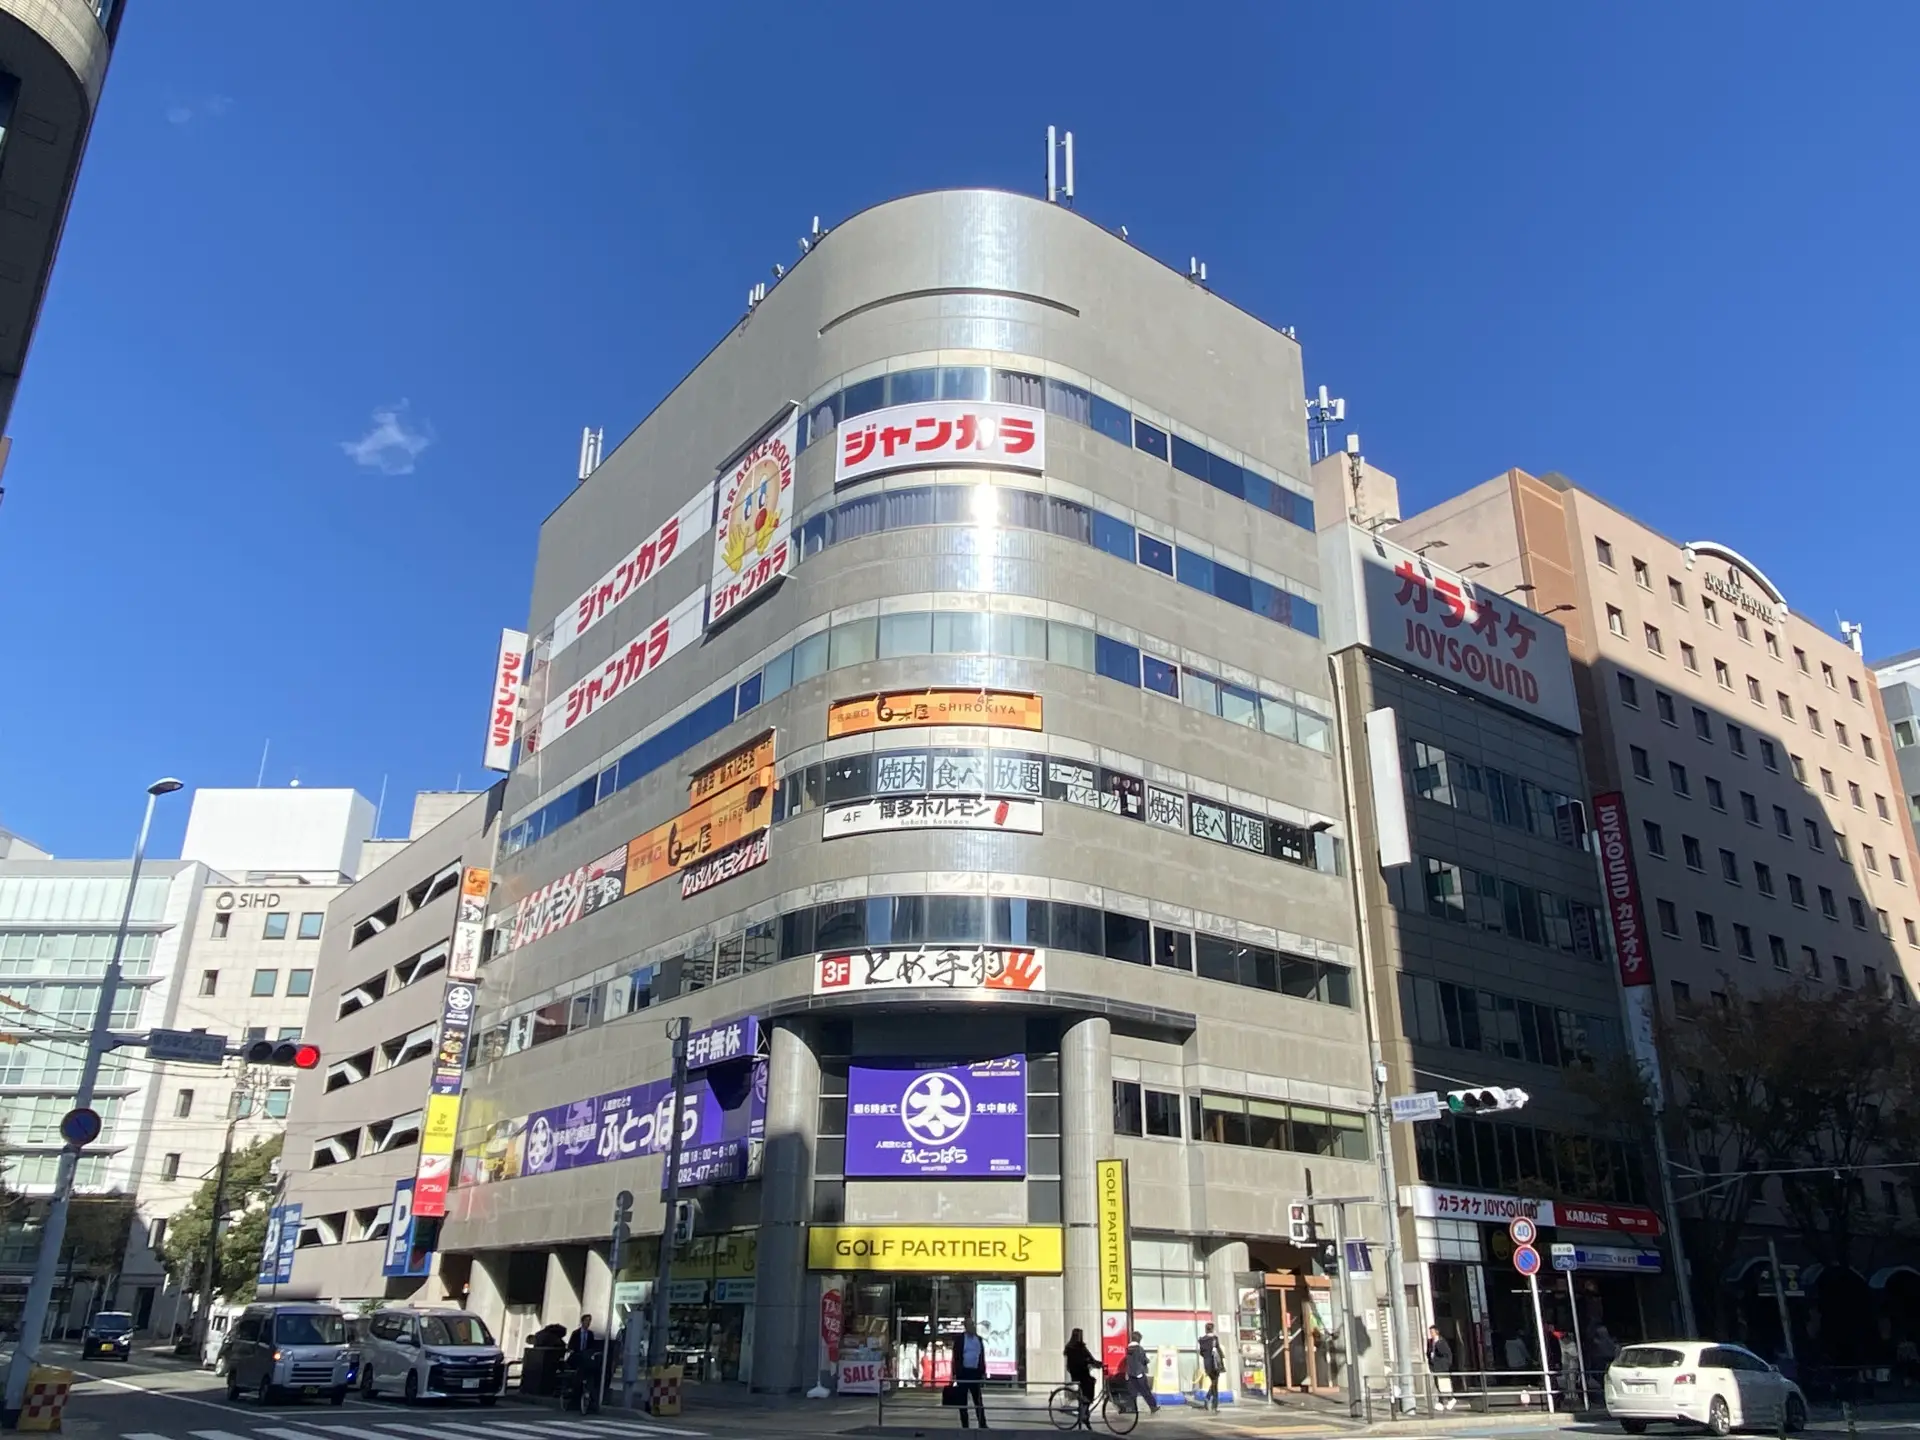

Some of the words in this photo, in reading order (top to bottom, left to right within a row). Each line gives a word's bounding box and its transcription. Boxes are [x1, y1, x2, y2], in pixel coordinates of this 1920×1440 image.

[844, 414, 1035, 467] ジャンカラ
[577, 516, 679, 634] ジャンカラ
[714, 540, 788, 619] ジャンカラ
[1394, 560, 1537, 660] カラオケ
[564, 617, 670, 729] ジャンカラ
[1405, 618, 1540, 705] JOYSOUND
[493, 651, 521, 747] ジャンカラ
[938, 702, 1017, 717] SHIROKIYA
[1050, 766, 1093, 785] オーダー
[879, 799, 991, 821] 博多ホルモン
[1068, 785, 1120, 812] バイキング
[842, 811, 862, 824] 4F
[1599, 805, 1631, 899] JOYSOUND
[238, 893, 281, 908] SIHD
[1616, 903, 1643, 972] カラオケ
[823, 961, 849, 983] 3F
[901, 1147, 968, 1164] ふとっぱら
[420, 1184, 443, 1193] アコム
[1105, 1167, 1116, 1208] GOLF
[1438, 1195, 1481, 1214] カラオケ
[1484, 1199, 1537, 1220] JOYSOUND
[387, 1188, 412, 1266] P
[1516, 1226, 1530, 1237] 40
[836, 1239, 895, 1258] GOLF
[902, 1239, 1007, 1258] PARTNER
[1107, 1211, 1119, 1285] PARTNER
[842, 1364, 876, 1385] SALE
